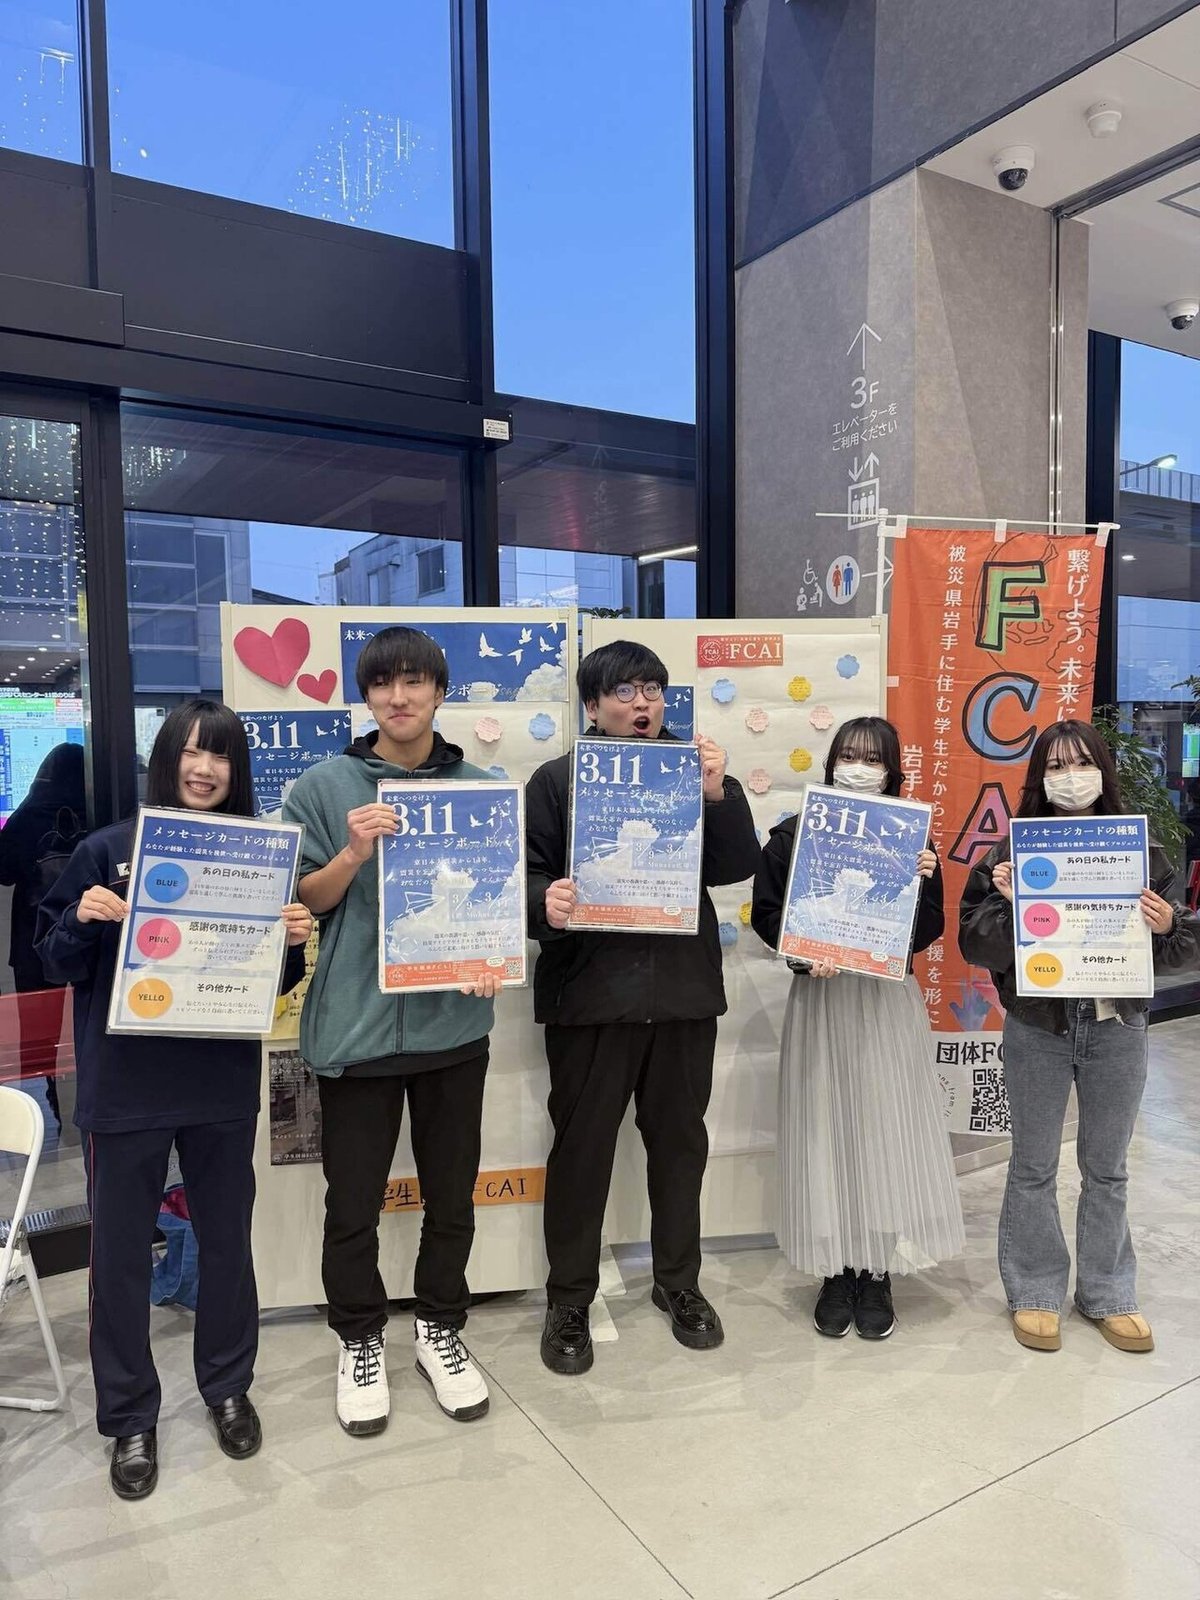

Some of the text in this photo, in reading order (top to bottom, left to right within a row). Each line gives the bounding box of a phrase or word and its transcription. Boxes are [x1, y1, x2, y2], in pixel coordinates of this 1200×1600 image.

[851, 376, 880, 409] 3F
[832, 403, 897, 435] エレベーターを
[832, 420, 898, 451] ご利用ください
[729, 642, 782, 659] FCAI
[243, 721, 303, 750] 3.11
[256, 750, 334, 761] ッセージボード
[580, 752, 644, 785] 3.11
[392, 801, 457, 837] 3.11
[807, 802, 867, 839] 3.11
[153, 826, 289, 850] メッセージカードの種類
[1021, 825, 1139, 837] メッセージカードの種類
[1067, 855, 1131, 864] あの日の私カード
[202, 866, 276, 880] あの日の私カード
[155, 878, 179, 887] BLUE
[1065, 903, 1136, 911] 感謝の気持ちカード
[189, 921, 271, 935] 感謝の気持ちカード
[148, 935, 170, 944] PINK
[1082, 956, 1127, 964] その他カード
[197, 983, 249, 994] その他カード
[138, 993, 165, 1002] YELLO
